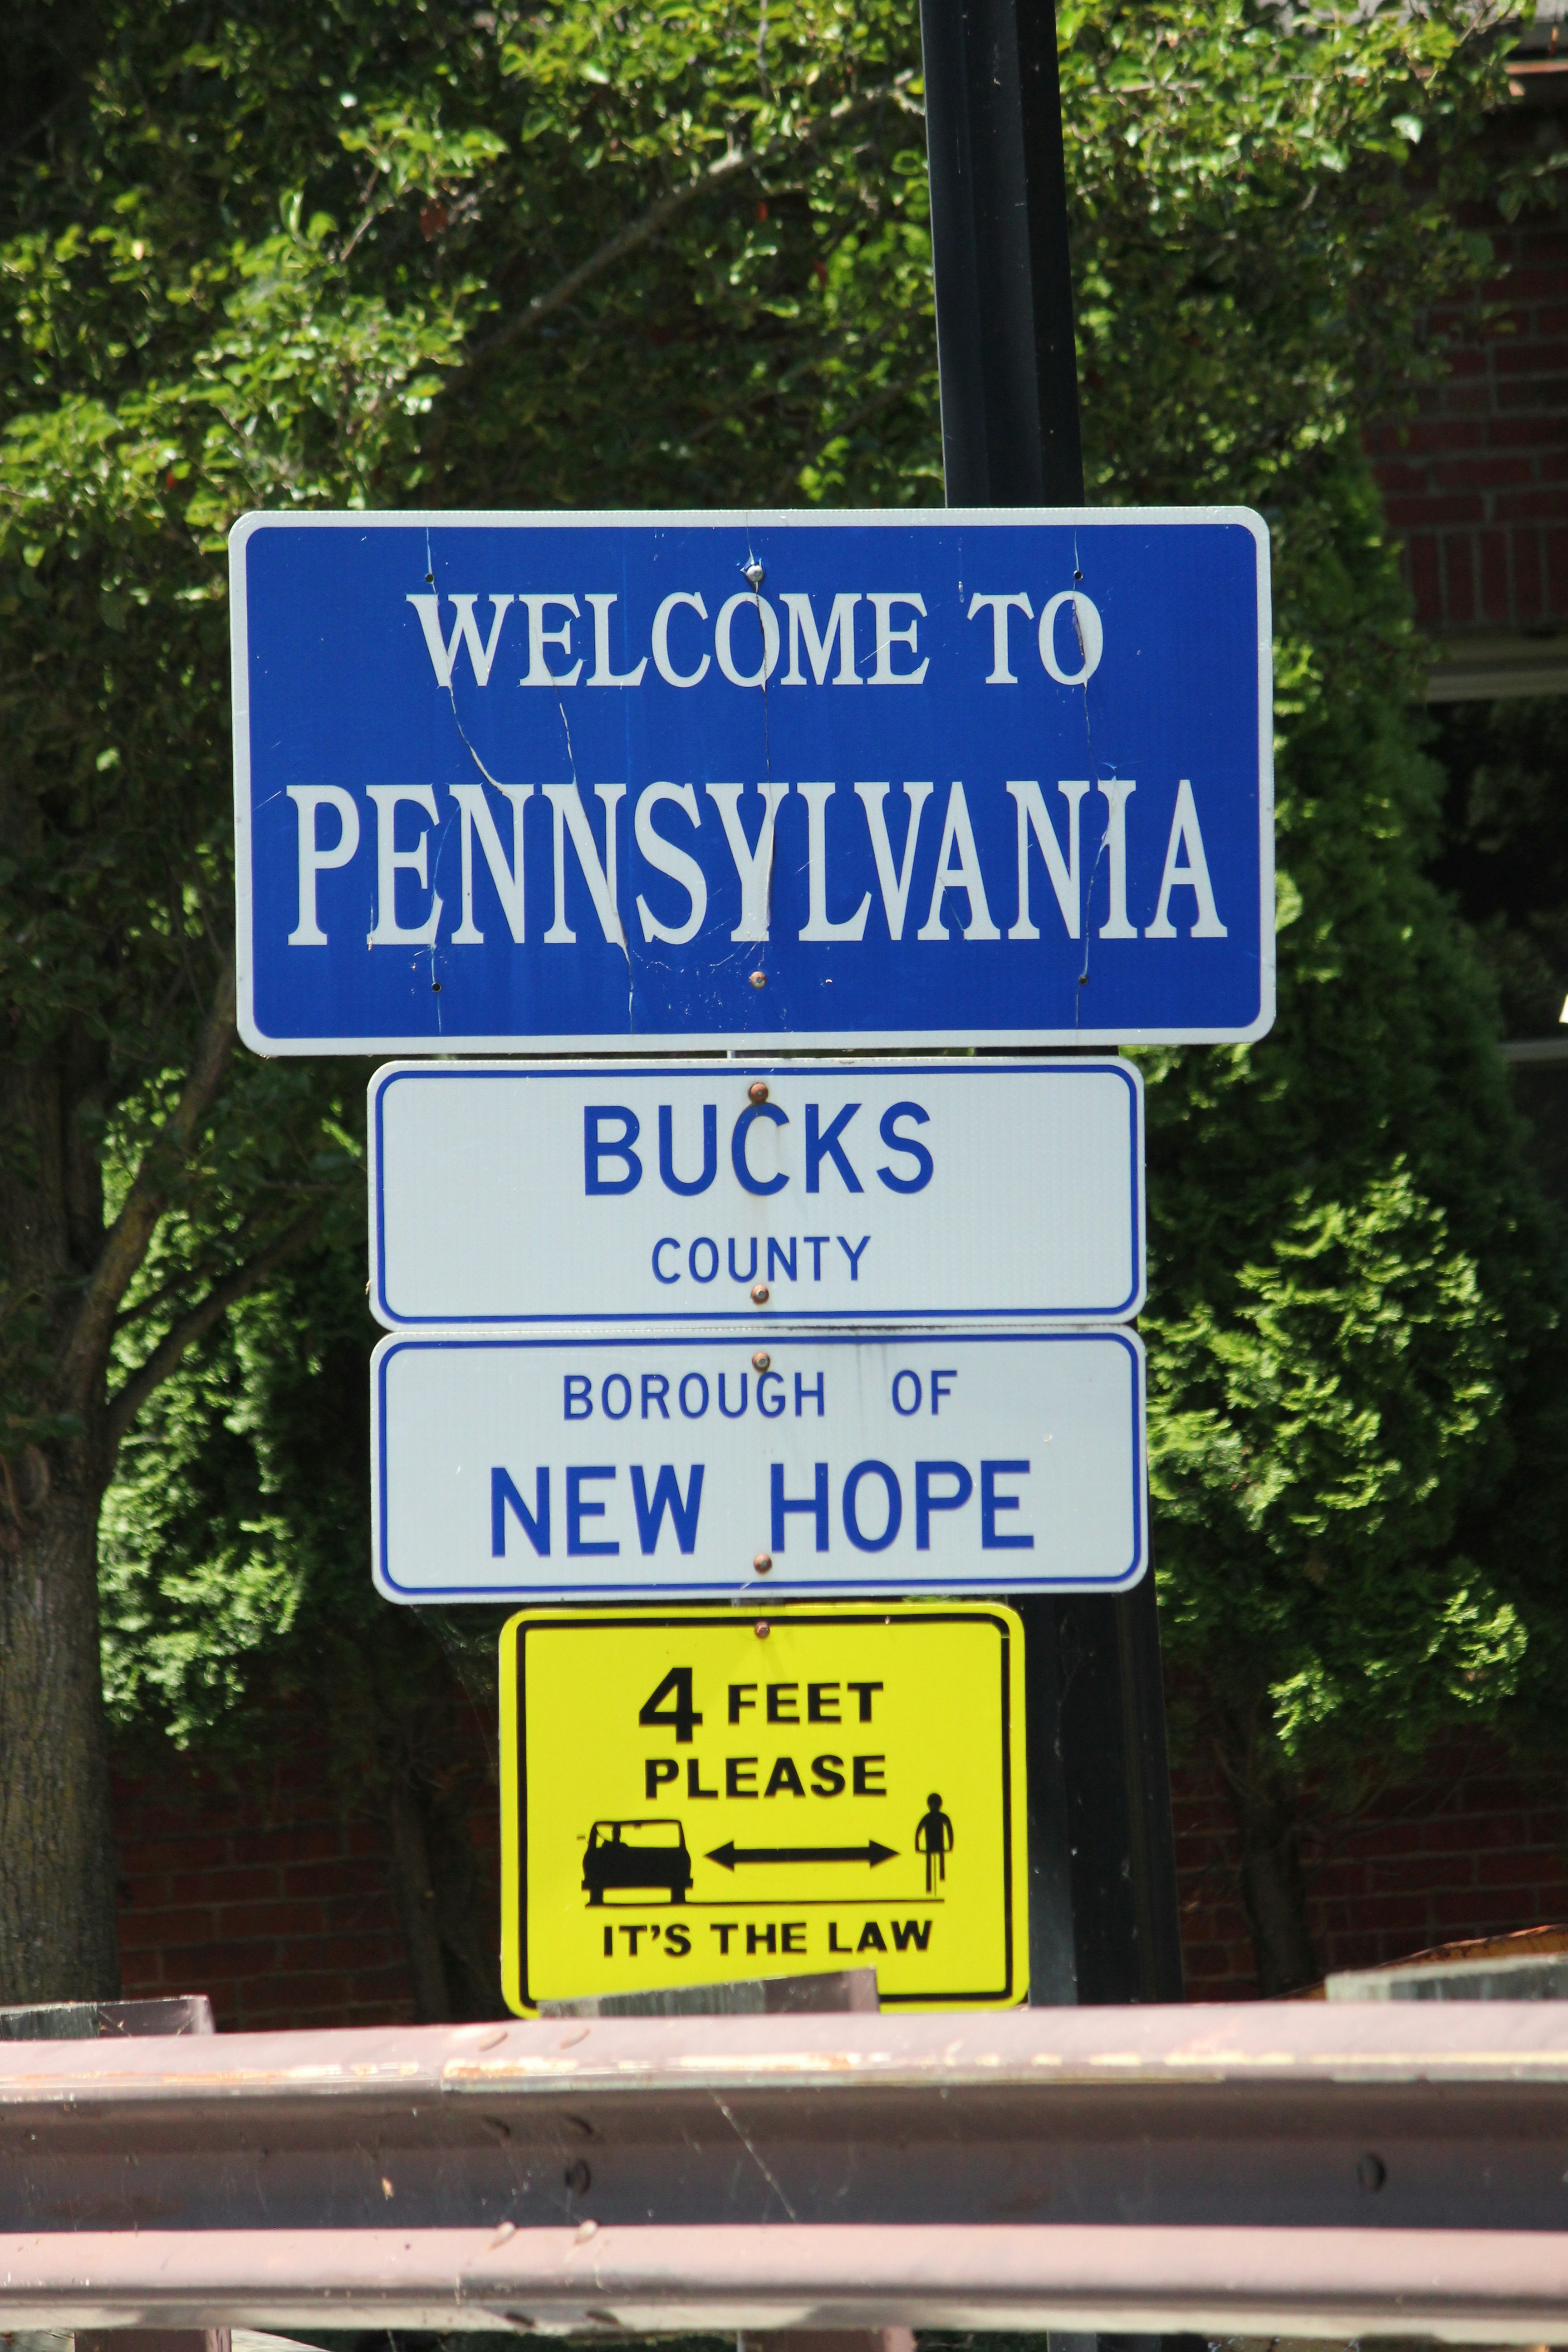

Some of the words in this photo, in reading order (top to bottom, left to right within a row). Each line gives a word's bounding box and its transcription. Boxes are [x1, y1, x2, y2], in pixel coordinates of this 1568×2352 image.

[406, 591, 930, 688] WELCOME
[968, 591, 1103, 686] TO
[286, 779, 1228, 946] PENNSYLVANIA
[583, 1101, 934, 1196] BUCKS
[651, 1235, 871, 1284] COUNTY
[563, 1372, 825, 1421] BOROUGH
[892, 1369, 958, 1416] OF
[491, 1464, 704, 1557] NEW
[770, 1459, 1034, 1553] HOPE
[638, 1666, 703, 1744] 4
[727, 1681, 884, 1725] FEET
[645, 1754, 887, 1800] PLEASE
[603, 1923, 692, 1958] IT'S
[710, 1921, 808, 1956] THE
[828, 1920, 933, 1954] LAW
